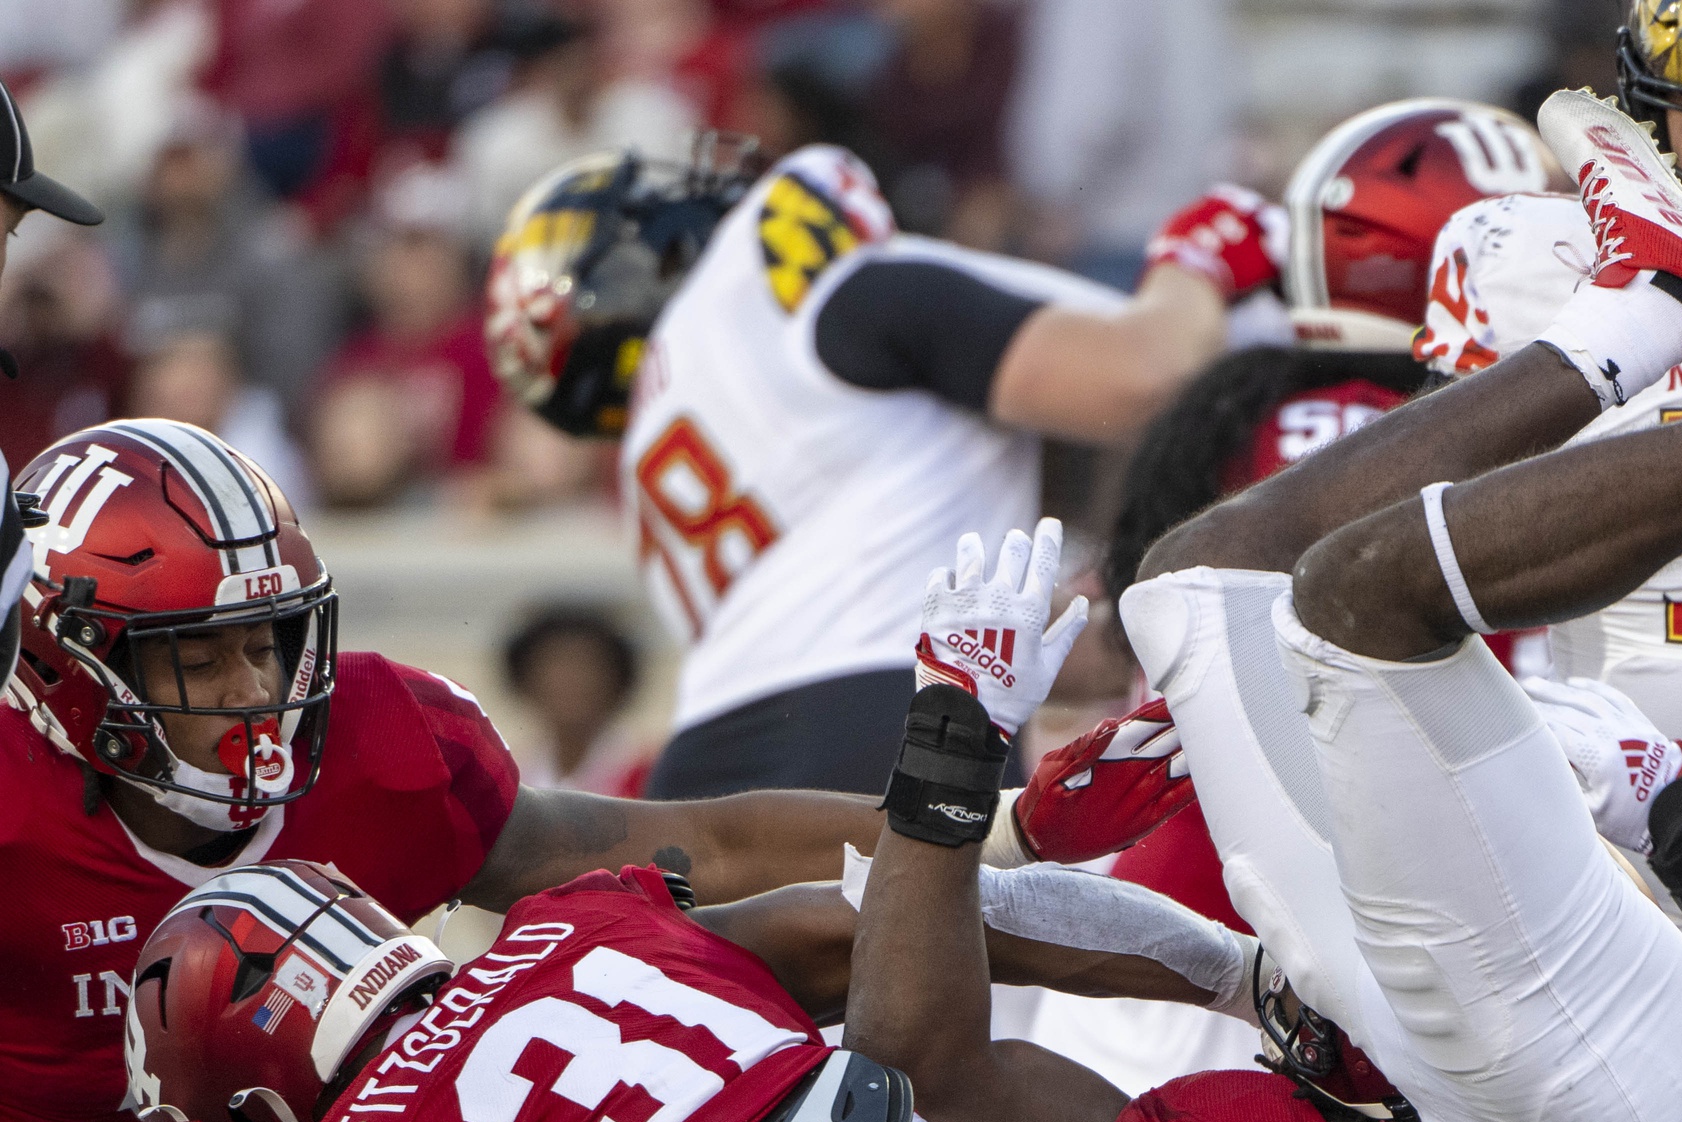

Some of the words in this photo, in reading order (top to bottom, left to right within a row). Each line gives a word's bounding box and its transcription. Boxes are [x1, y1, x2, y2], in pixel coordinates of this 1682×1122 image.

[245, 573, 283, 599] LEO
[947, 633, 1016, 688] adidas
[1636, 741, 1667, 802] adidas
[348, 943, 422, 1011] INDIANA
